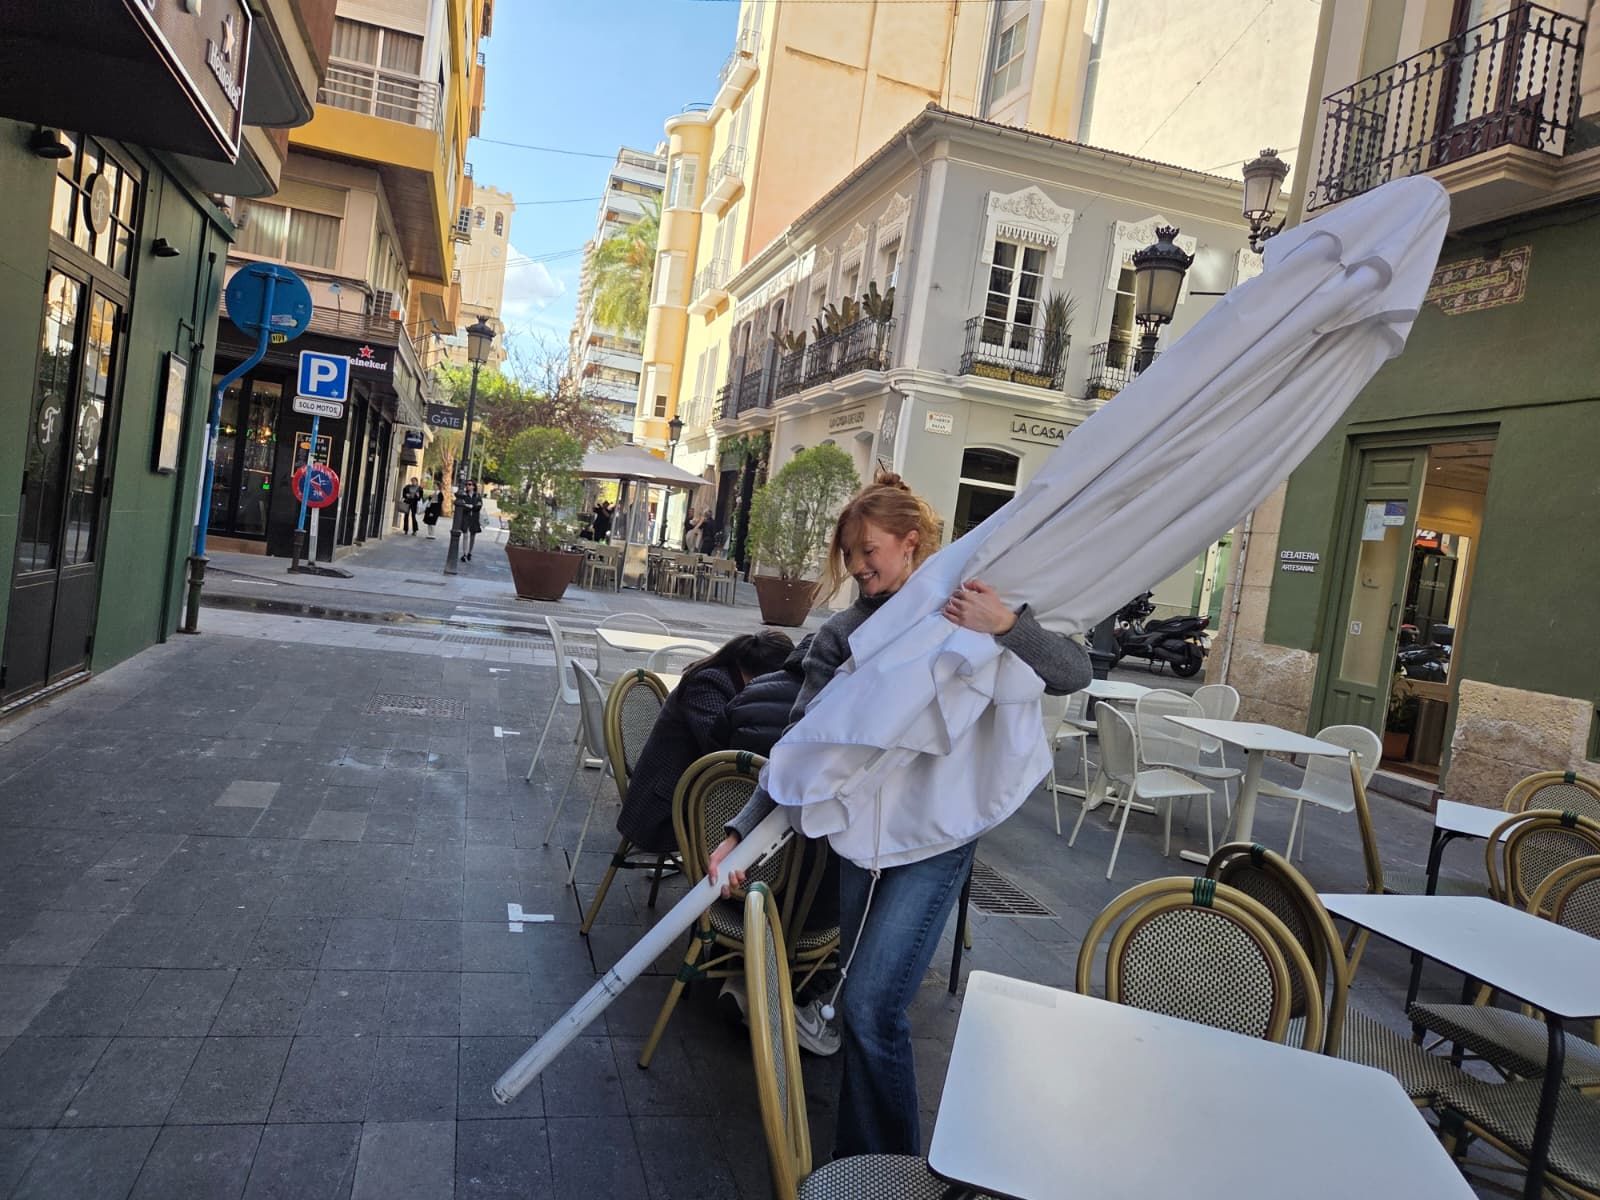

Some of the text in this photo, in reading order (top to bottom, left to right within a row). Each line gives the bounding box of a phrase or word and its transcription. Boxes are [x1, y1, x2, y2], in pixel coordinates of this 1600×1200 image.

[350, 357, 387, 370] eineken
[308, 357, 338, 392] P
[299, 401, 338, 414] SOLO MOTOS
[431, 414, 460, 428] GATE
[1012, 421, 1027, 434] LA
[1031, 424, 1065, 440] CASA
[1281, 550, 1319, 560] GELATERIA
